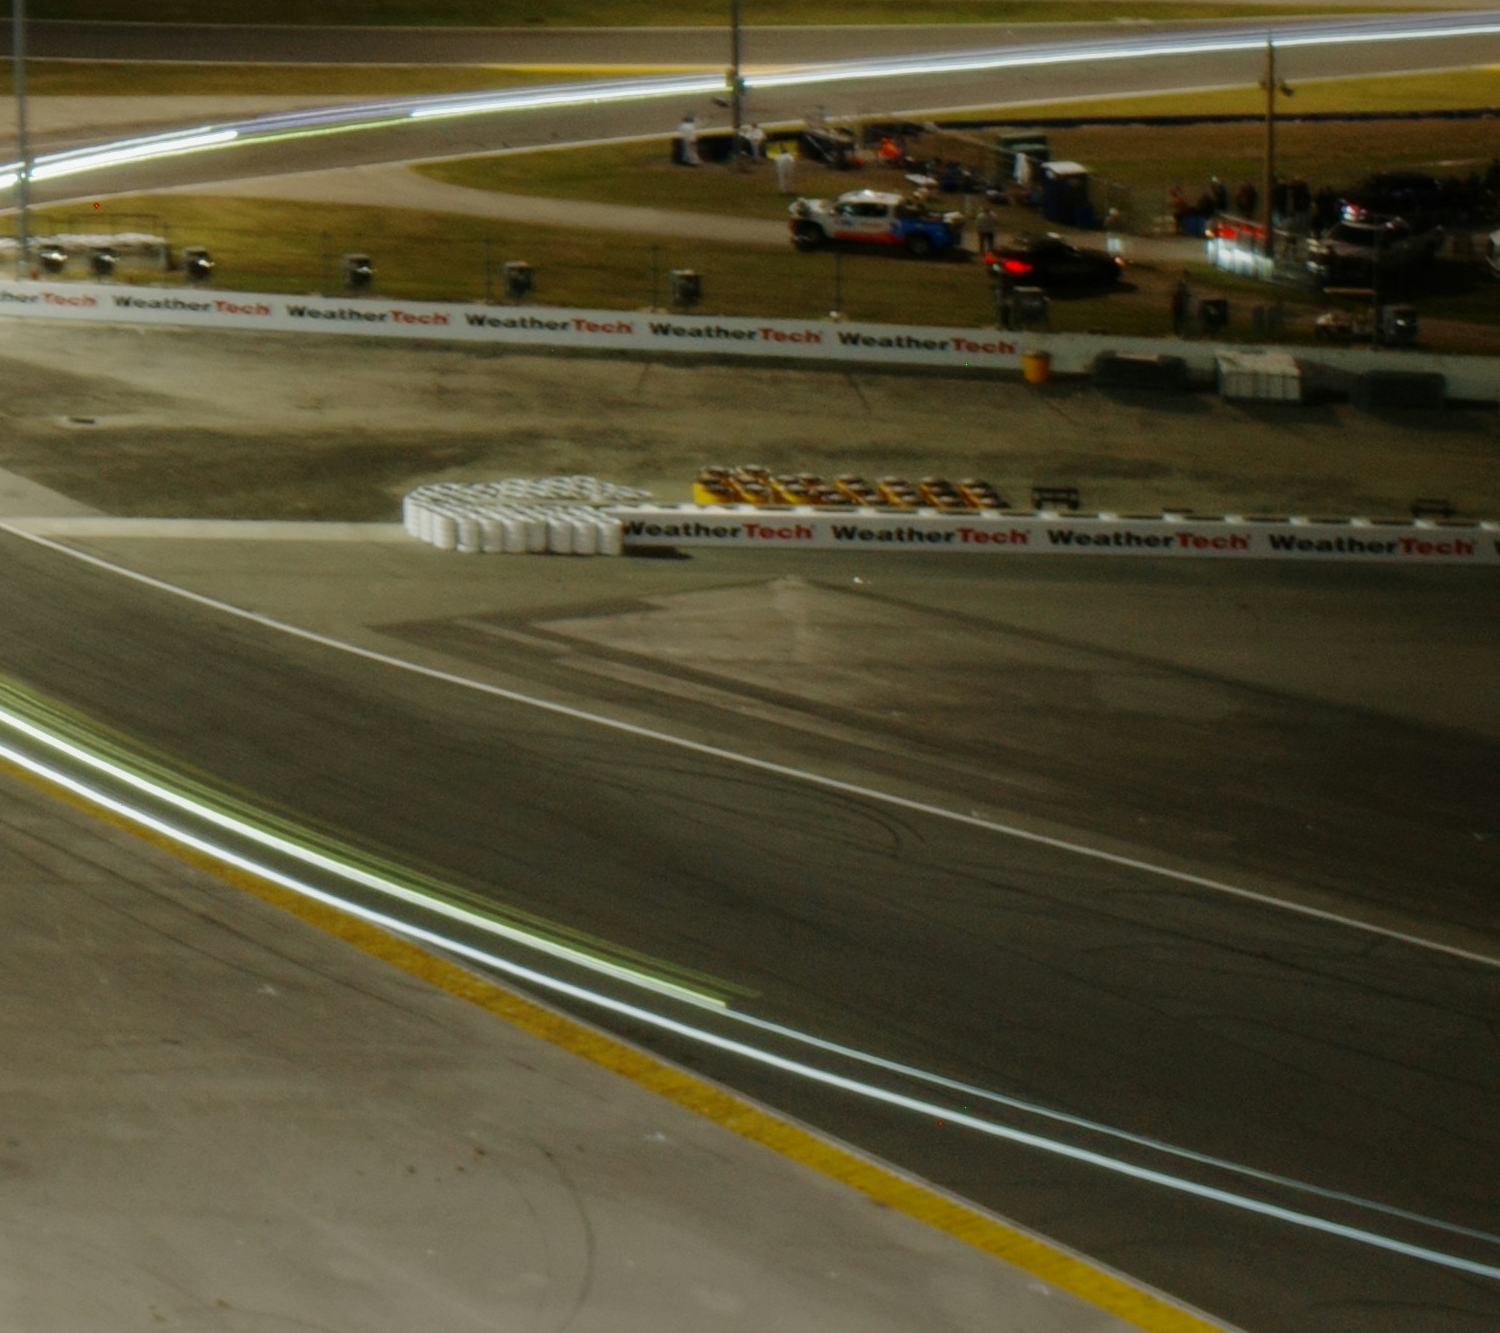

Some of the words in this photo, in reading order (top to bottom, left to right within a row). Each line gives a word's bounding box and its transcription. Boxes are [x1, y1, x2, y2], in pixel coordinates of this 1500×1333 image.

[111, 294, 272, 316] WeatherTech
[286, 304, 449, 325] WeatherTech
[465, 312, 633, 334] WeatherTech
[648, 321, 822, 344] WeatherTech
[837, 331, 1017, 355] WeatherTech
[622, 520, 816, 540] WeatherTech
[831, 524, 1030, 545] WeatherTech
[1046, 529, 1250, 550] WeatherTech
[1268, 534, 1477, 556] WeatherTech
